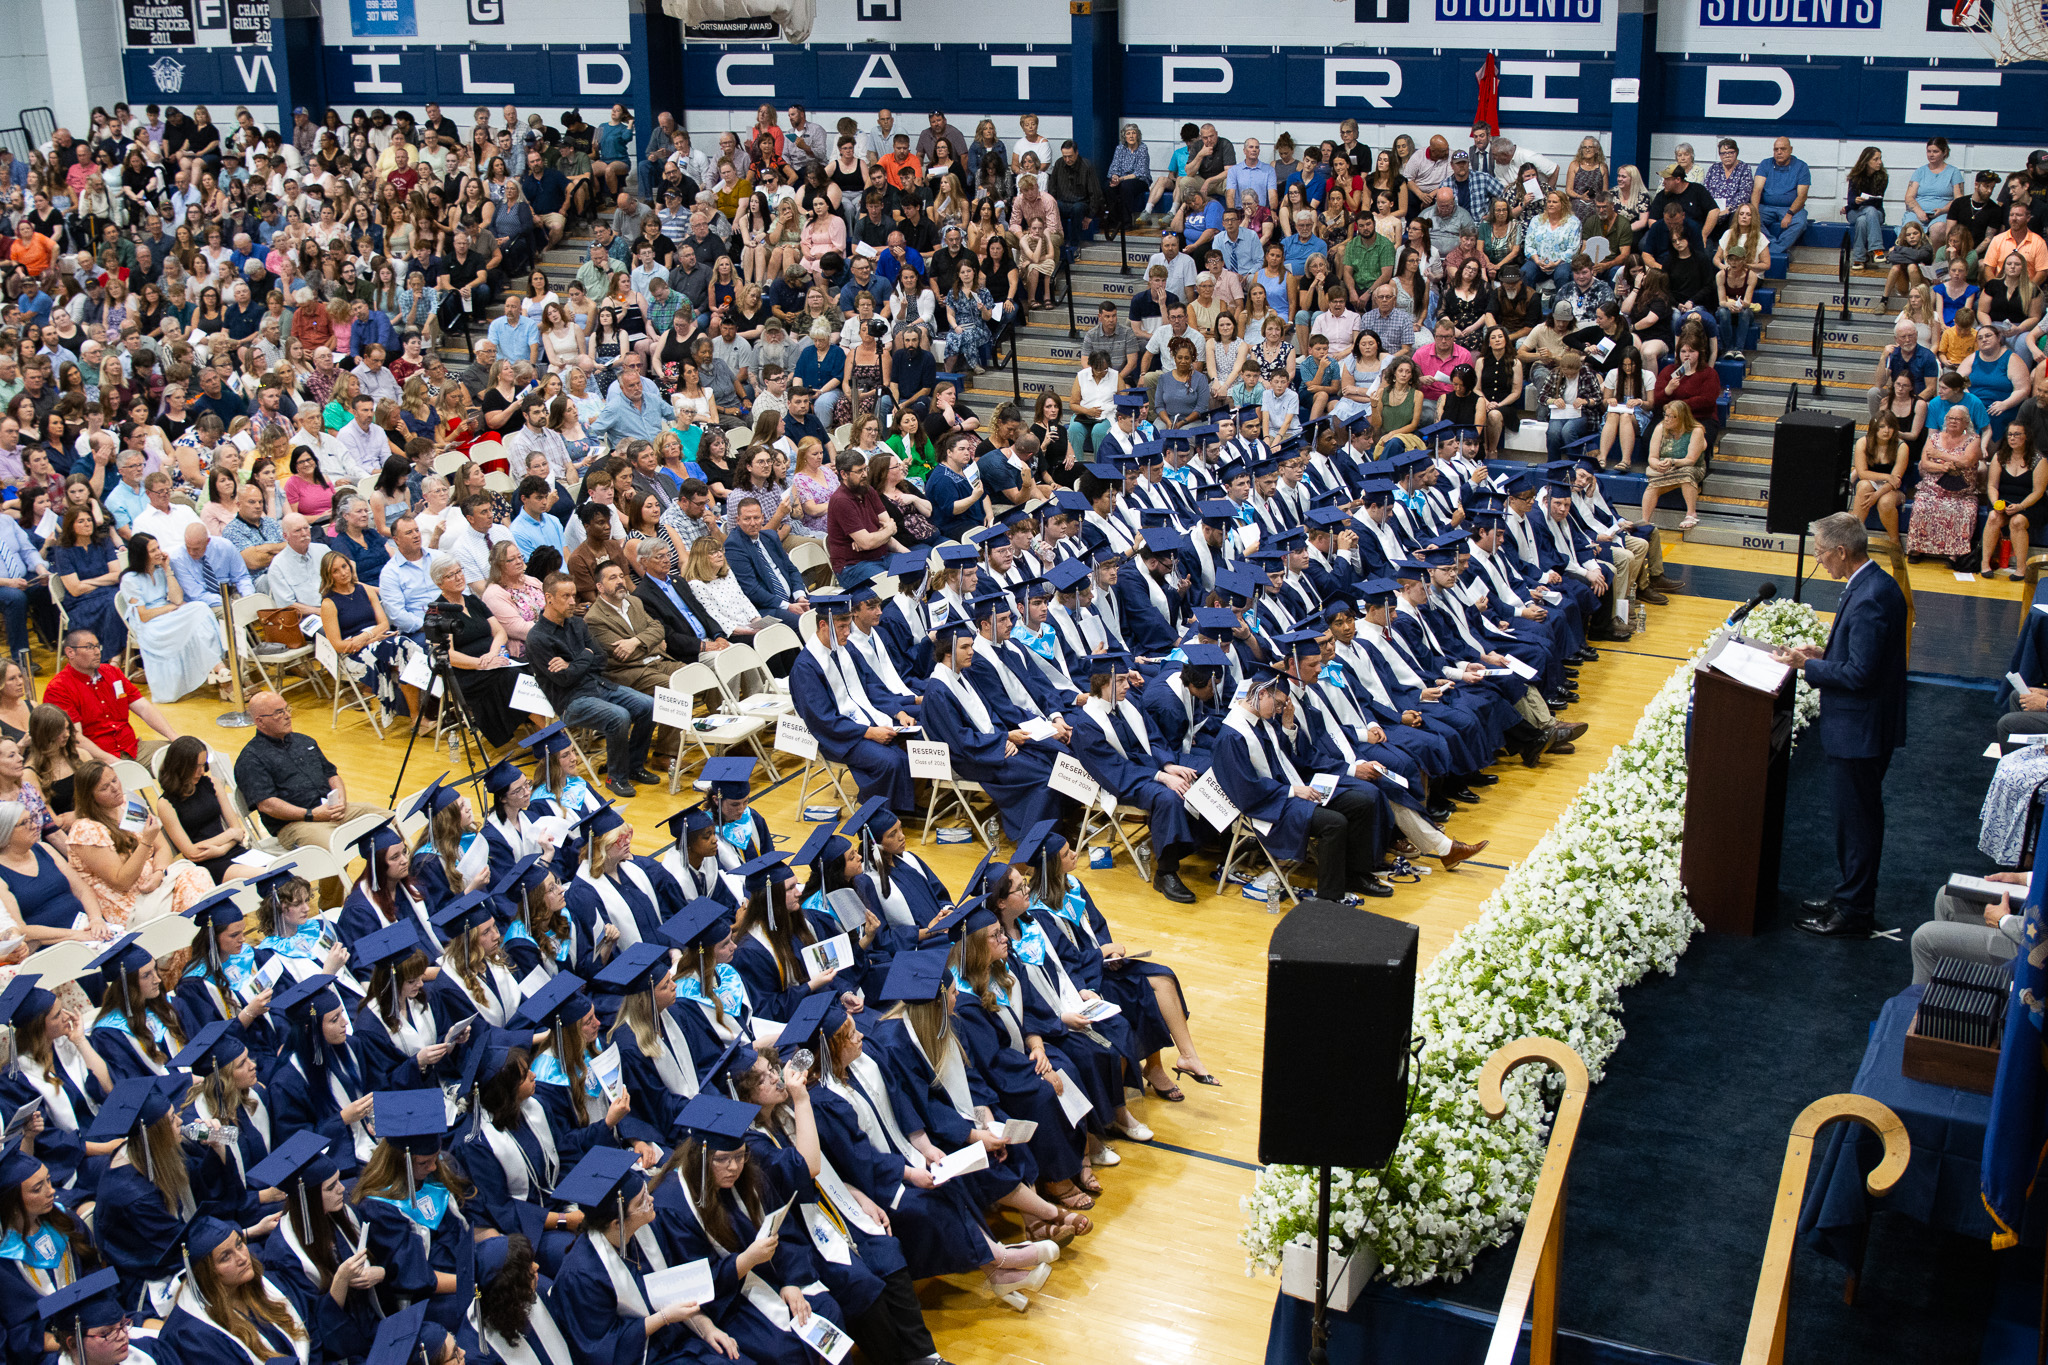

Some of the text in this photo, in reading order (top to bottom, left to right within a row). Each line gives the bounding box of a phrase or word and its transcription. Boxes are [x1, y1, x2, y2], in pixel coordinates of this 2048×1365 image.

[133, 5, 184, 18] CHAMPIONS
[366, 11, 399, 21] 307 WINS
[128, 17, 191, 31] GIRLS SOCCER
[233, 17, 261, 30] GIRLS
[150, 32, 172, 44] 2011
[1128, 254, 1150, 262] ROW
[1103, 284, 1125, 293] ROW
[1864, 298, 1871, 306] 7
[1077, 316, 1098, 325] ROW
[1852, 334, 1859, 343] 6
[1051, 349, 1073, 358] ROW
[1838, 371, 1846, 380] 5
[1023, 382, 1045, 392] ROW
[1743, 537, 1784, 550] ROW 1
[522, 680, 540, 689] MSA
[658, 694, 688, 708] RESERVED
[782, 721, 810, 734] RESERV
[782, 732, 794, 740] Class
[912, 748, 946, 756] RESERVED
[1058, 772, 1071, 782] Class
[1198, 788, 1211, 800] Class
